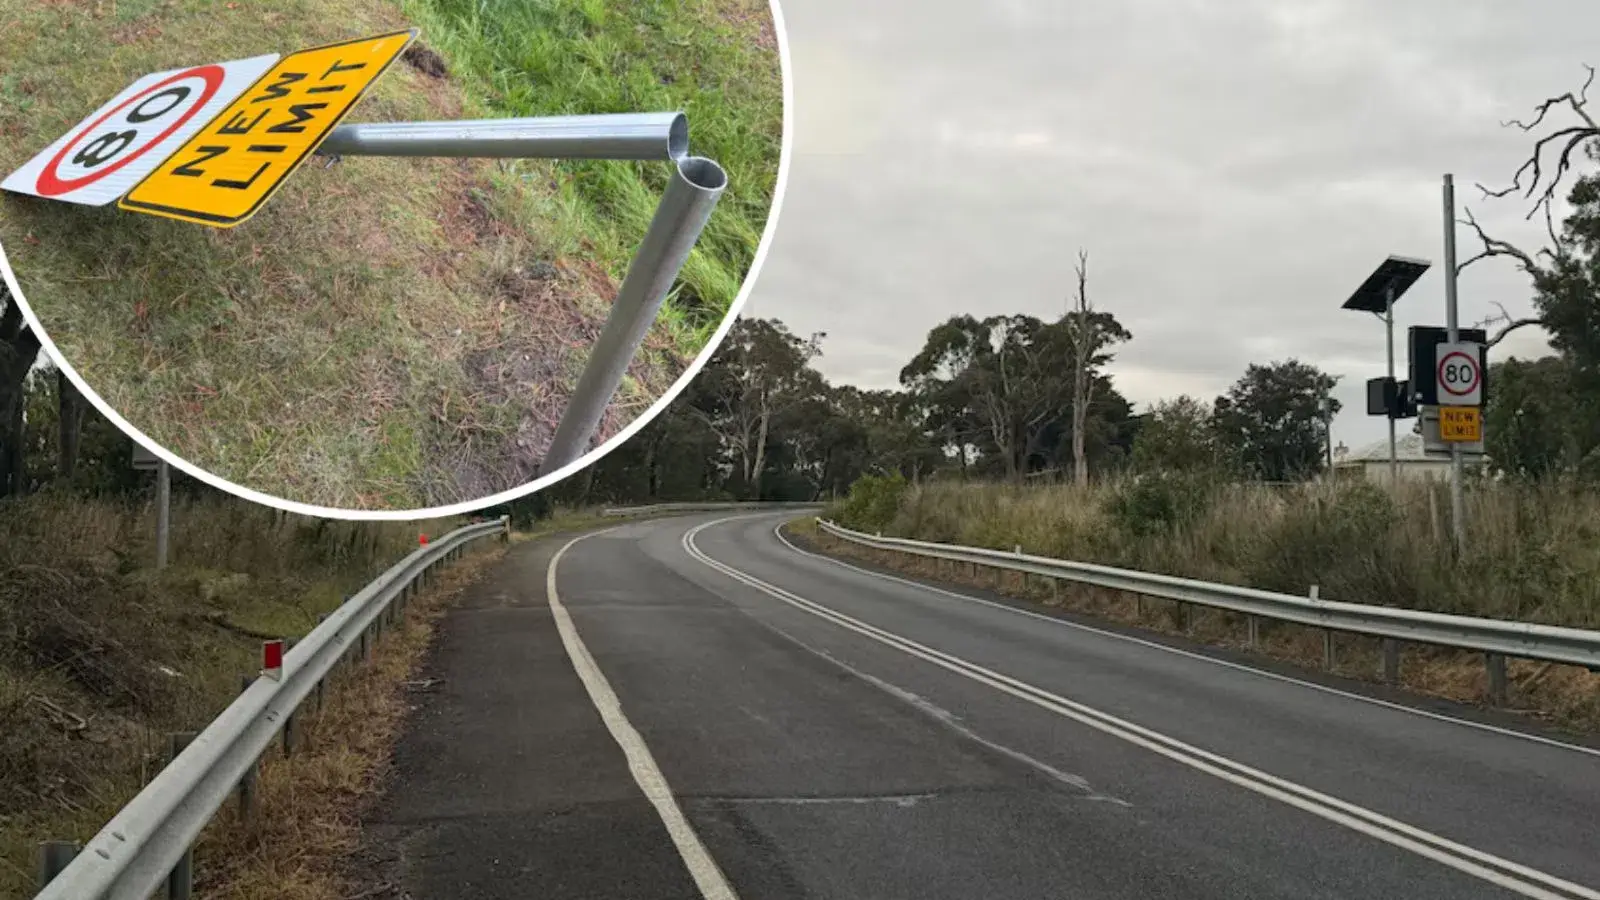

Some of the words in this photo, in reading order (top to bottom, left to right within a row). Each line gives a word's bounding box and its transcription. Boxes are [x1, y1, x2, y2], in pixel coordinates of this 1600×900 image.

[72, 86, 192, 168] 80
[170, 72, 308, 177] NEW
[210, 59, 368, 190] LIMIT
[1445, 364, 1473, 384] 80
[1443, 425, 1475, 436] LIMIT
[1444, 411, 1475, 422] NEW
